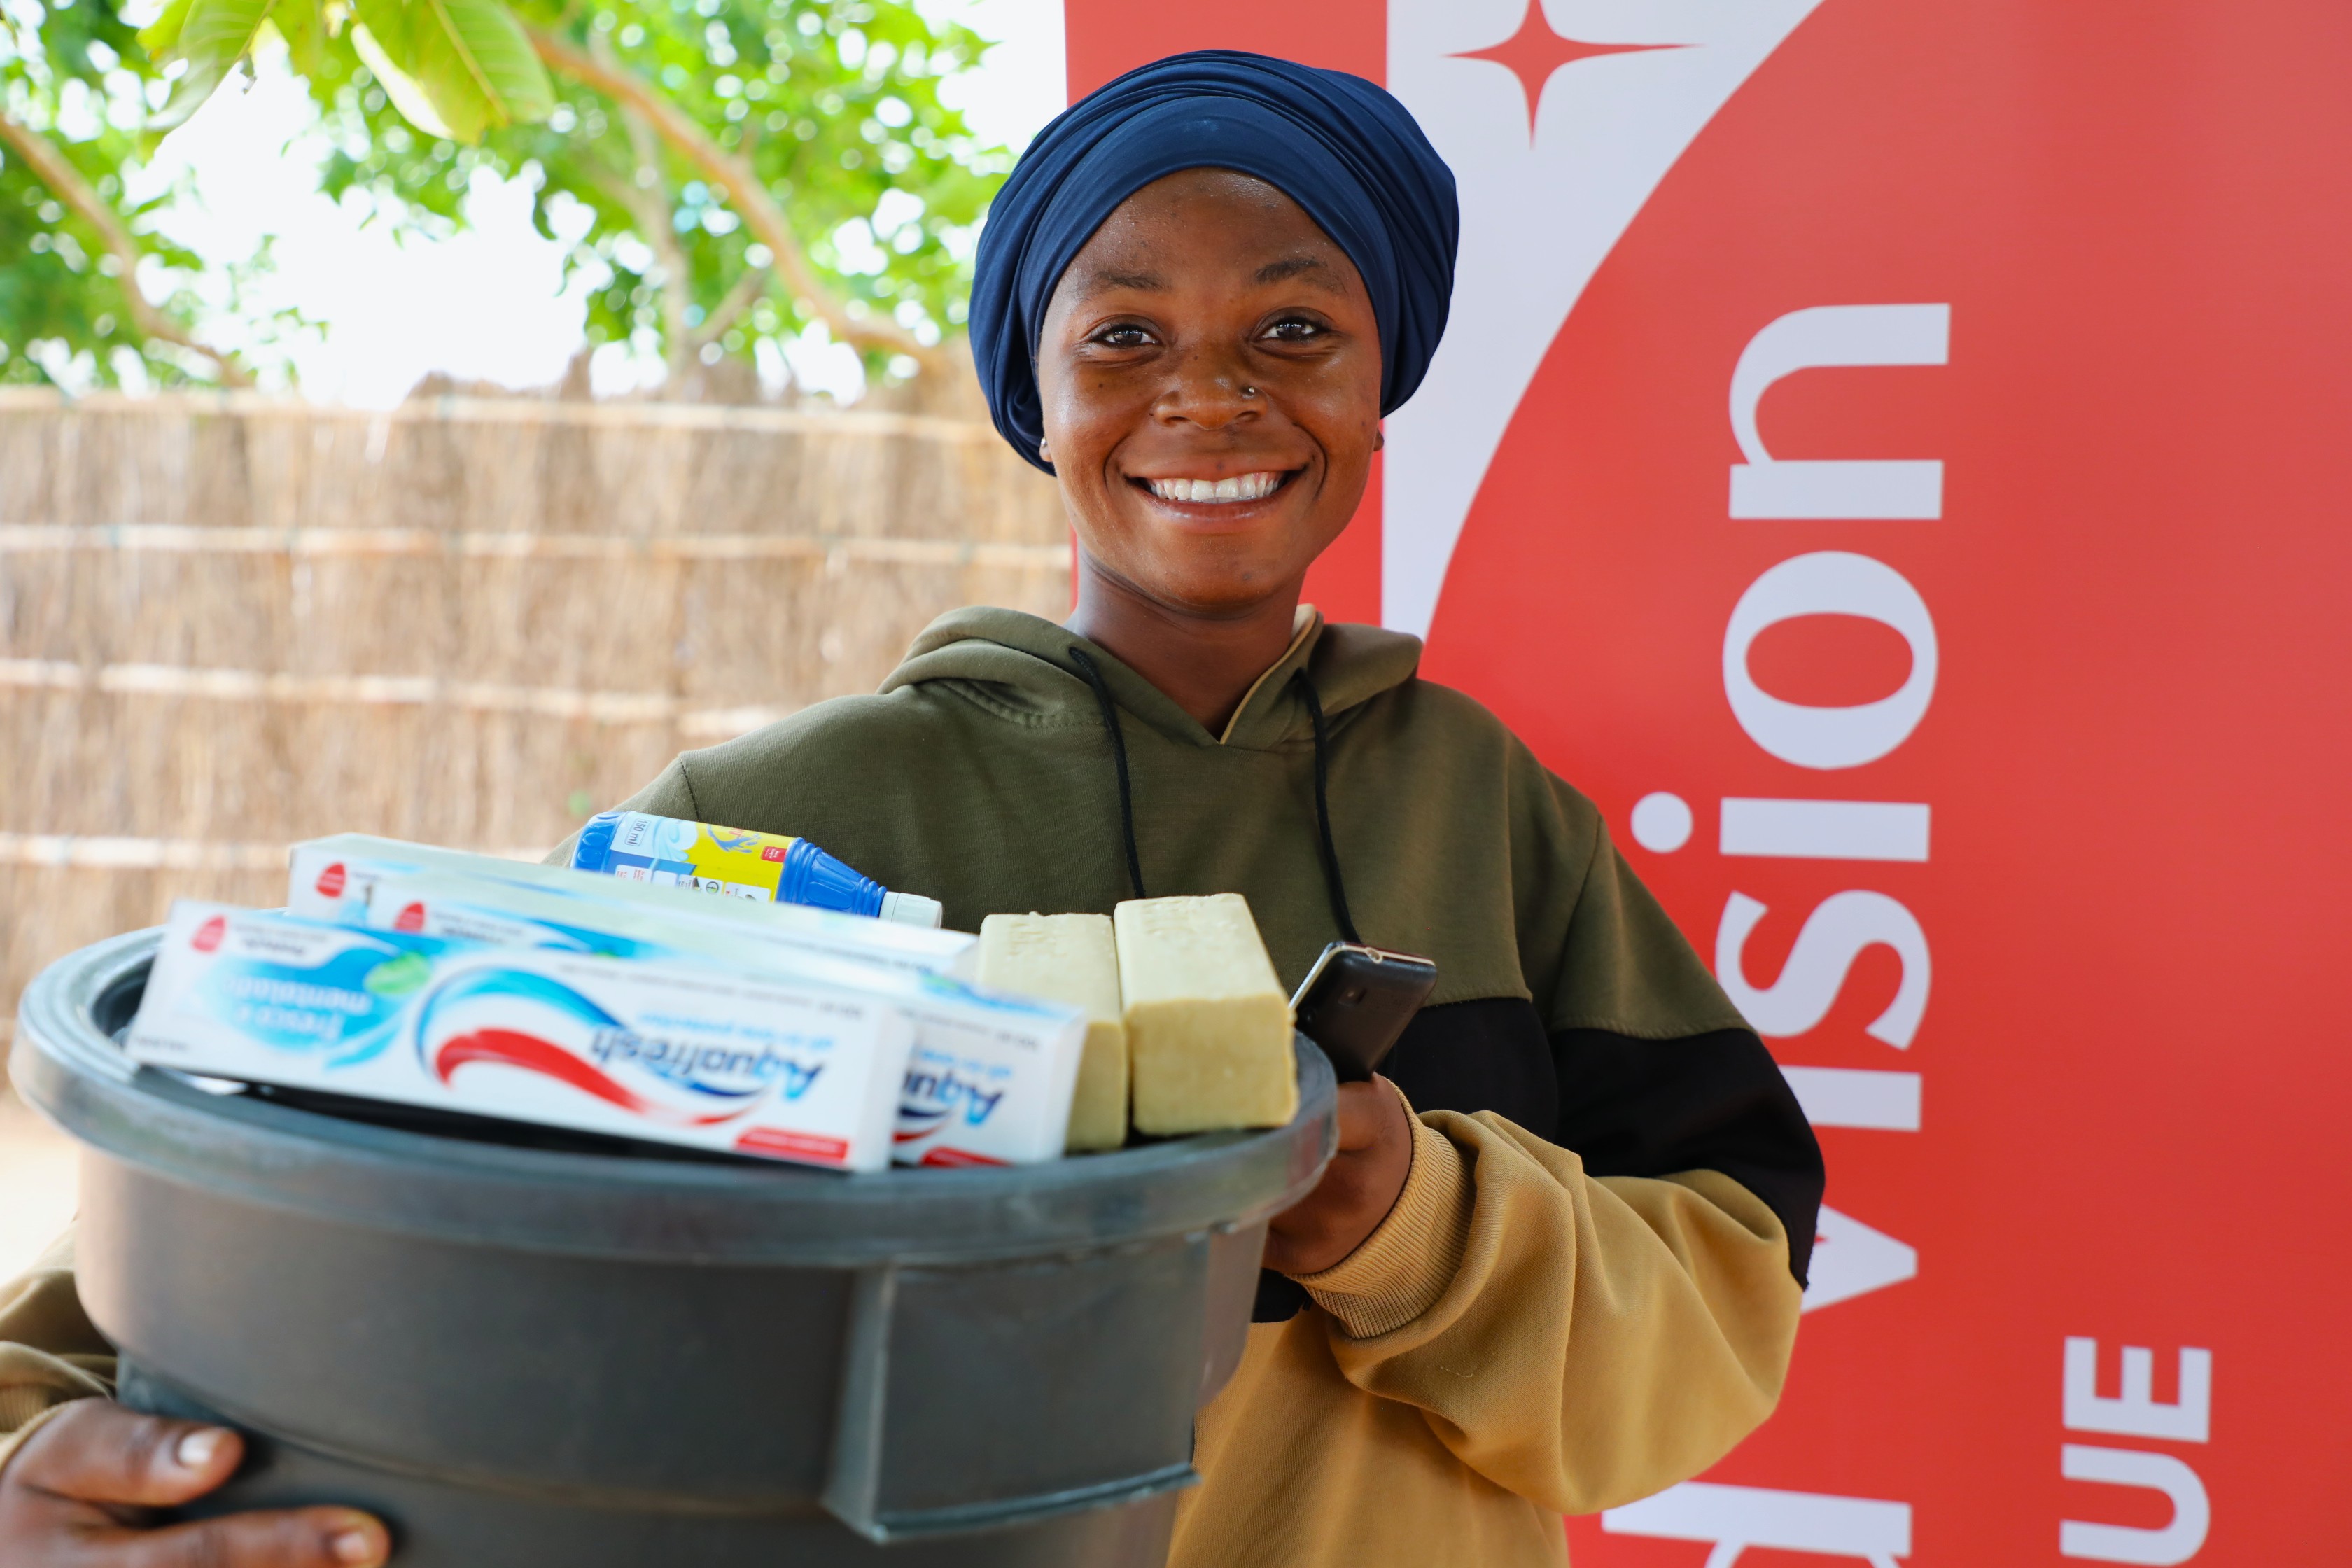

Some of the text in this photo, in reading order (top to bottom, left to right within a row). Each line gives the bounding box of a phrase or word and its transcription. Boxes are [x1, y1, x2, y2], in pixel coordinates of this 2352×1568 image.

[627, 818, 648, 846] 150 ml
[591, 1027, 826, 1102] Aquafresh
